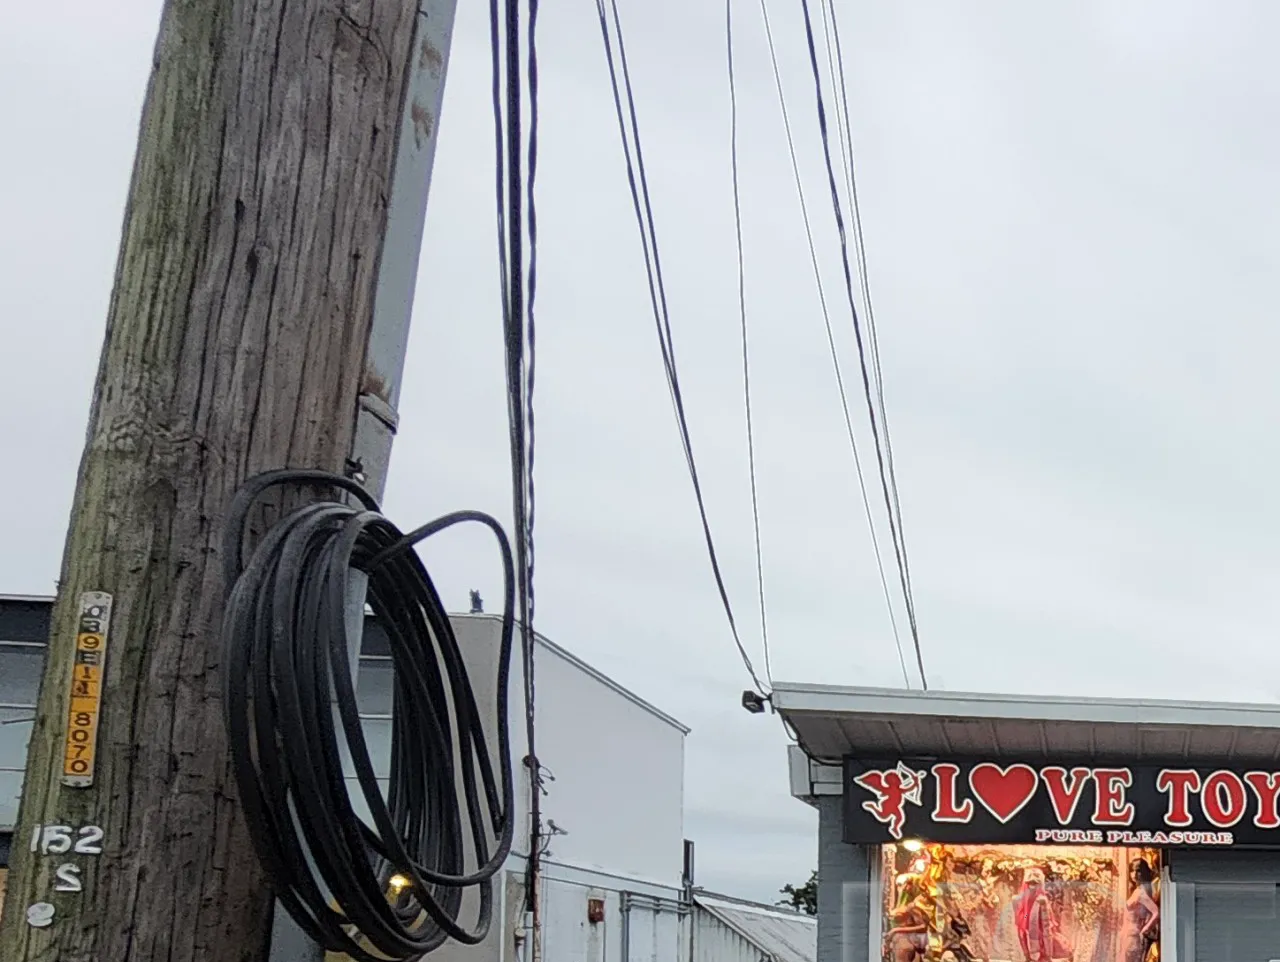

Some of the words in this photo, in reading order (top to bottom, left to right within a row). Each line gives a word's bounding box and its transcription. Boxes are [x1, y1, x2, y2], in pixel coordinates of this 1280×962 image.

[31, 823, 104, 855] 152
[1035, 829, 1103, 843] PURE
[1106, 830, 1234, 845] PLEASURE
